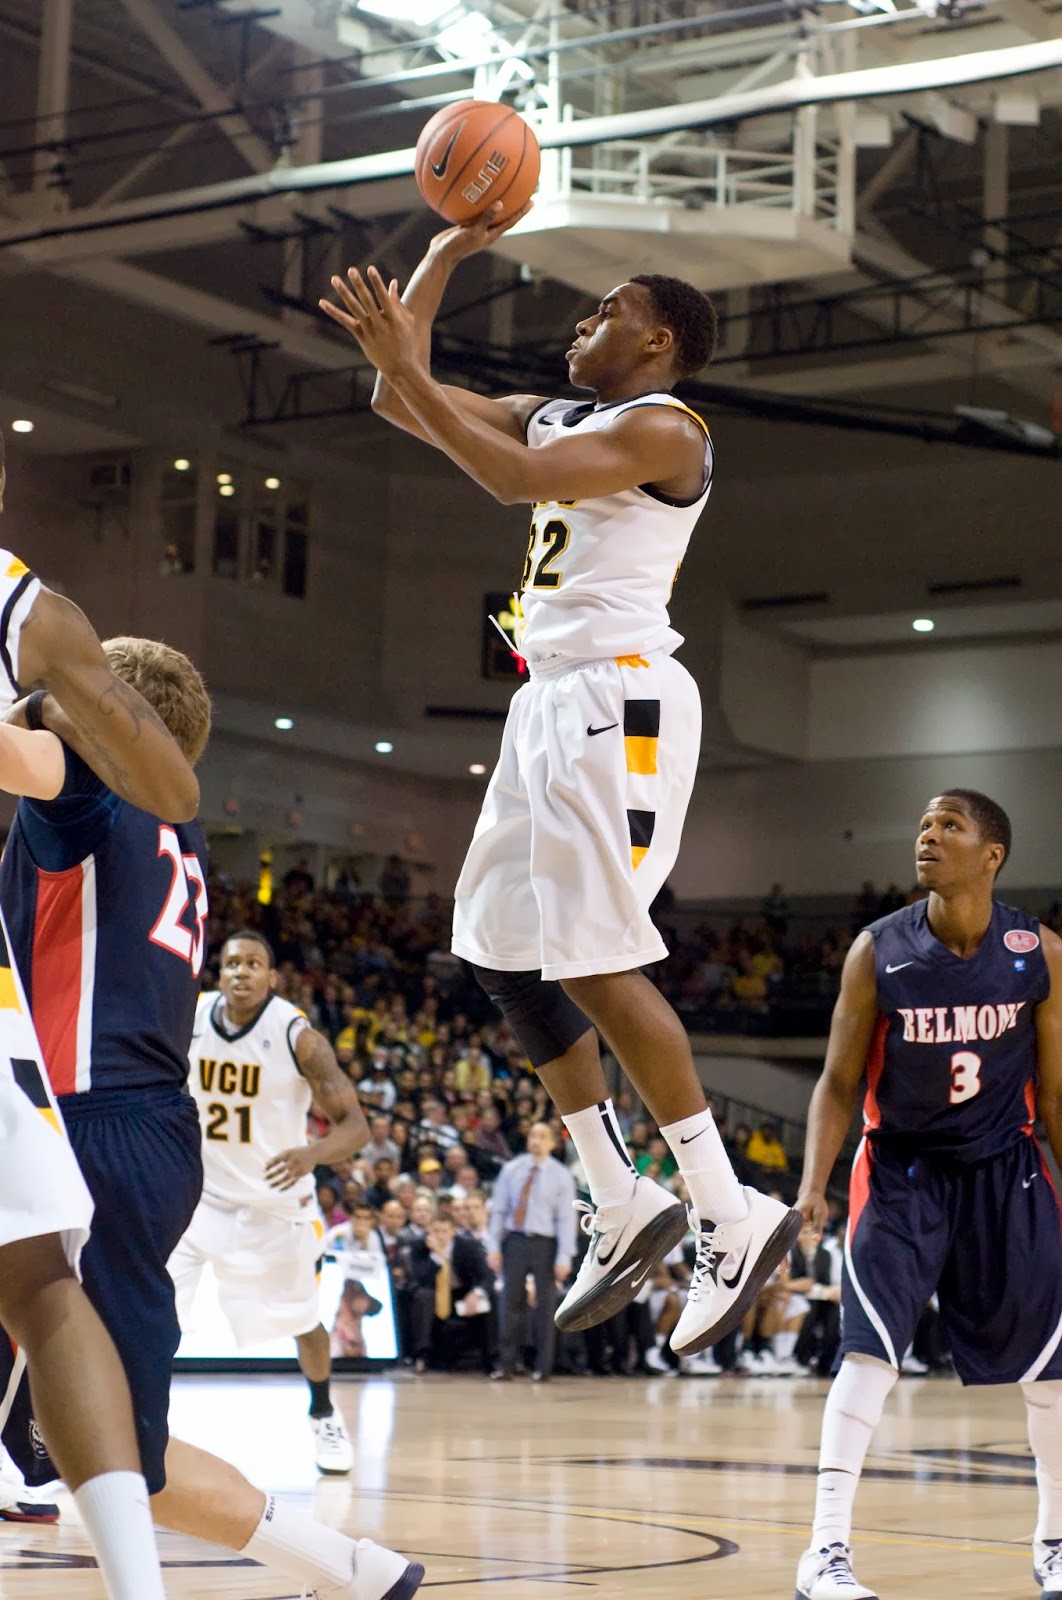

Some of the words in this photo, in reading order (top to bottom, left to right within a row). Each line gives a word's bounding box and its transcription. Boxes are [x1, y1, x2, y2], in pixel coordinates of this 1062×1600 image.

[461, 150, 510, 204] ELITE
[198, 1058, 262, 1098] VCU
[949, 1051, 983, 1105] 3
[206, 1101, 252, 1144] 21
